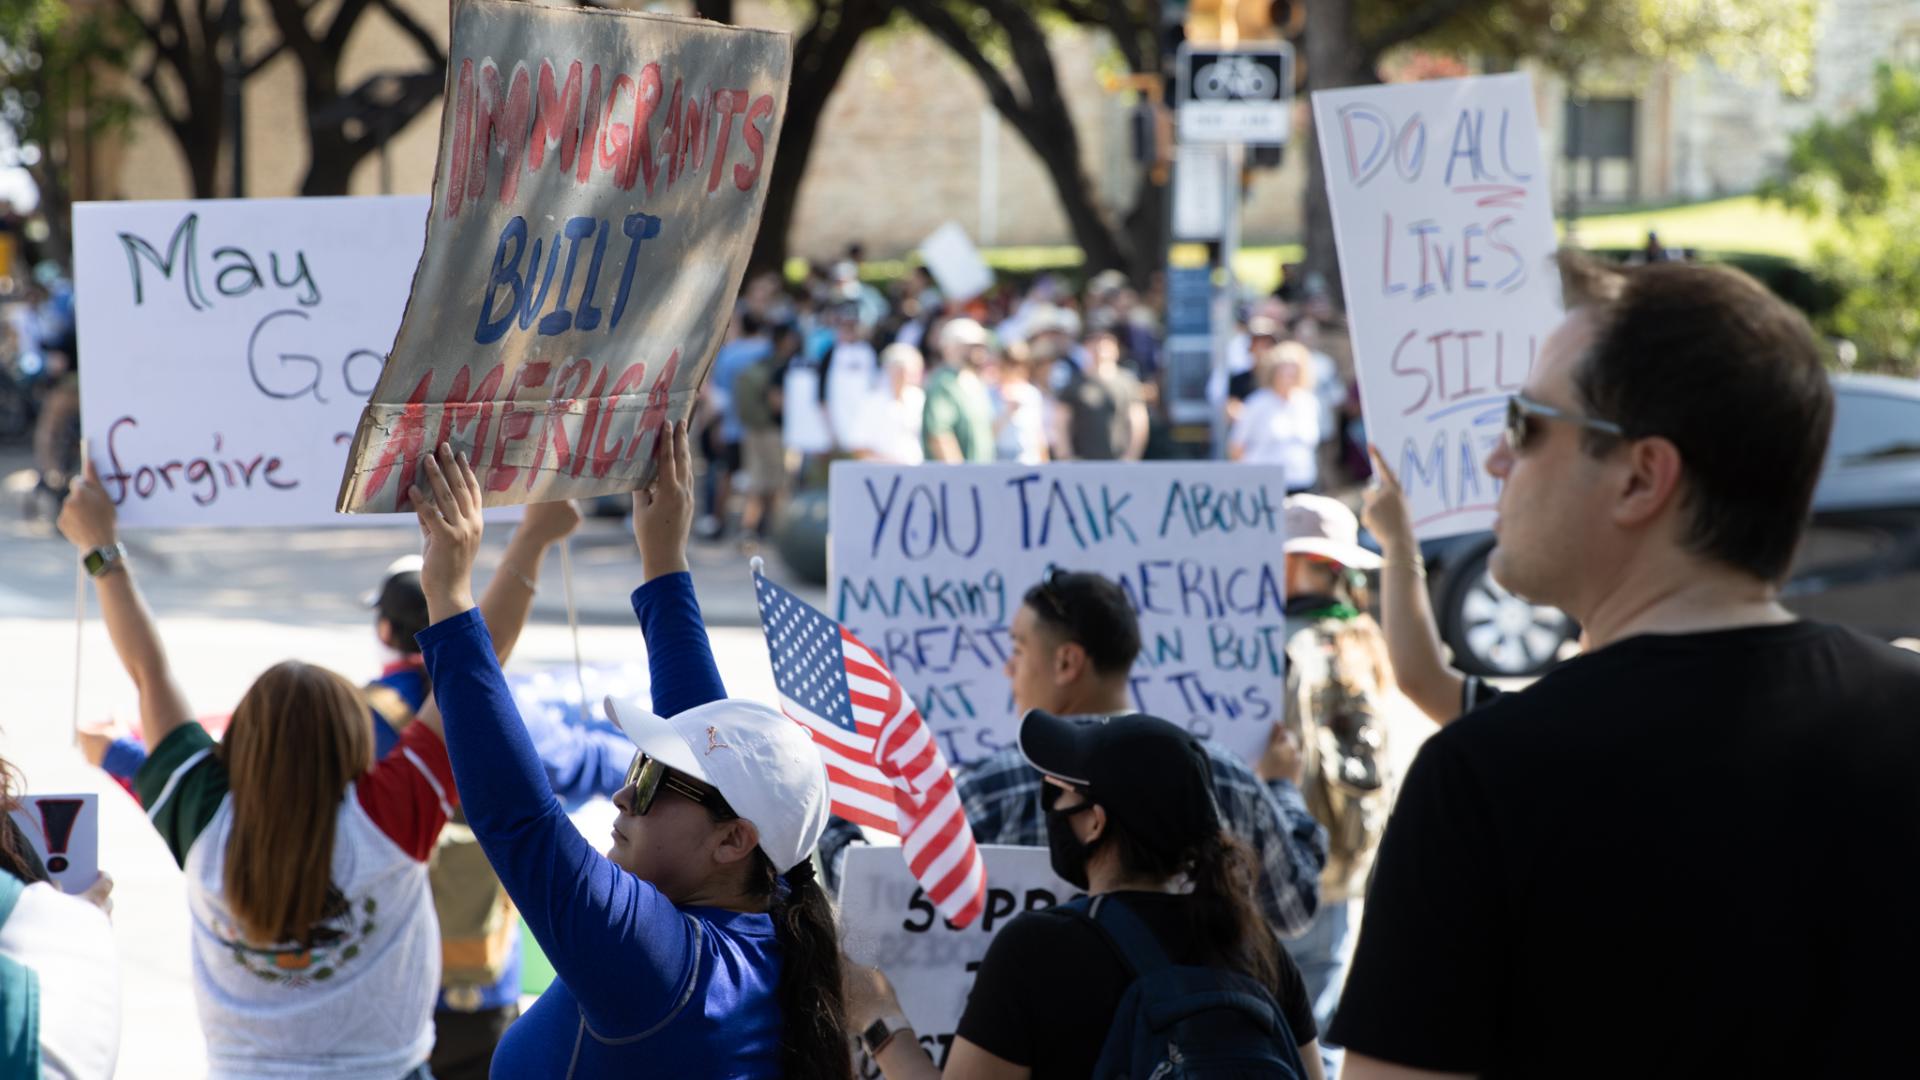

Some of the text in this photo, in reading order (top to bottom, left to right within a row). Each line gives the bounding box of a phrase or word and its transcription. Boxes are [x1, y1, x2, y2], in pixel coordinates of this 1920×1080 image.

[448, 56, 775, 219] IMMIGRANTS
[1337, 102, 1532, 188] DO ALL
[118, 212, 322, 311] May
[475, 212, 661, 345] BUILT
[1382, 209, 1530, 298] LIVES
[247, 309, 386, 404] Go
[103, 416, 300, 507] forgive
[363, 348, 681, 508] AMERICA
[865, 473, 983, 560] YOU
[1006, 472, 1139, 550] TALK
[1119, 557, 1287, 620] ERICA
[1208, 620, 1282, 678] BUT
